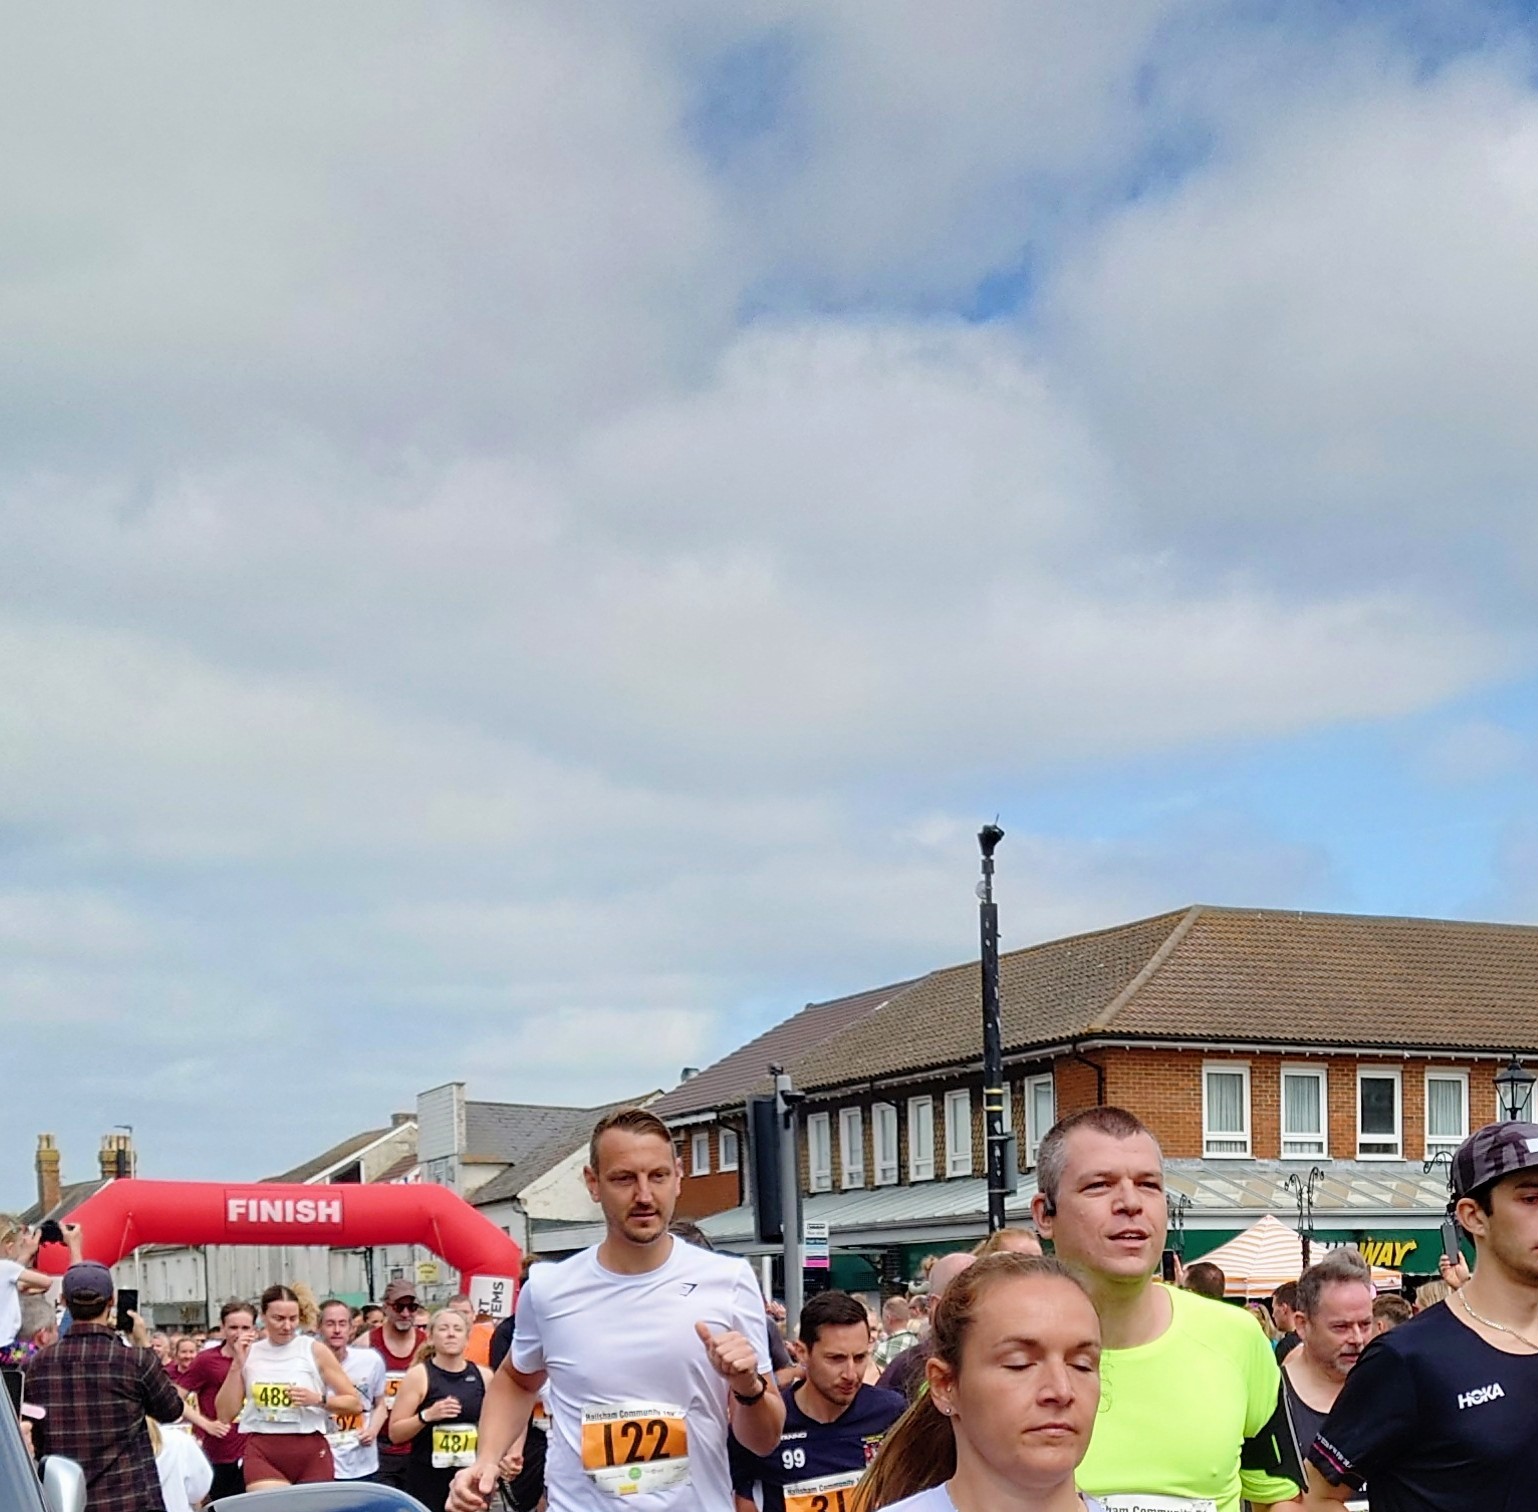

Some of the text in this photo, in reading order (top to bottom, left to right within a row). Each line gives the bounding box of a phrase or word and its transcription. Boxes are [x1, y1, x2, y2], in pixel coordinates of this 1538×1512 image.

[227, 1198, 341, 1224] FINISH
[1457, 1382, 1506, 1410] HOKA
[603, 1420, 671, 1467] 122
[781, 1448, 806, 1470] 99
